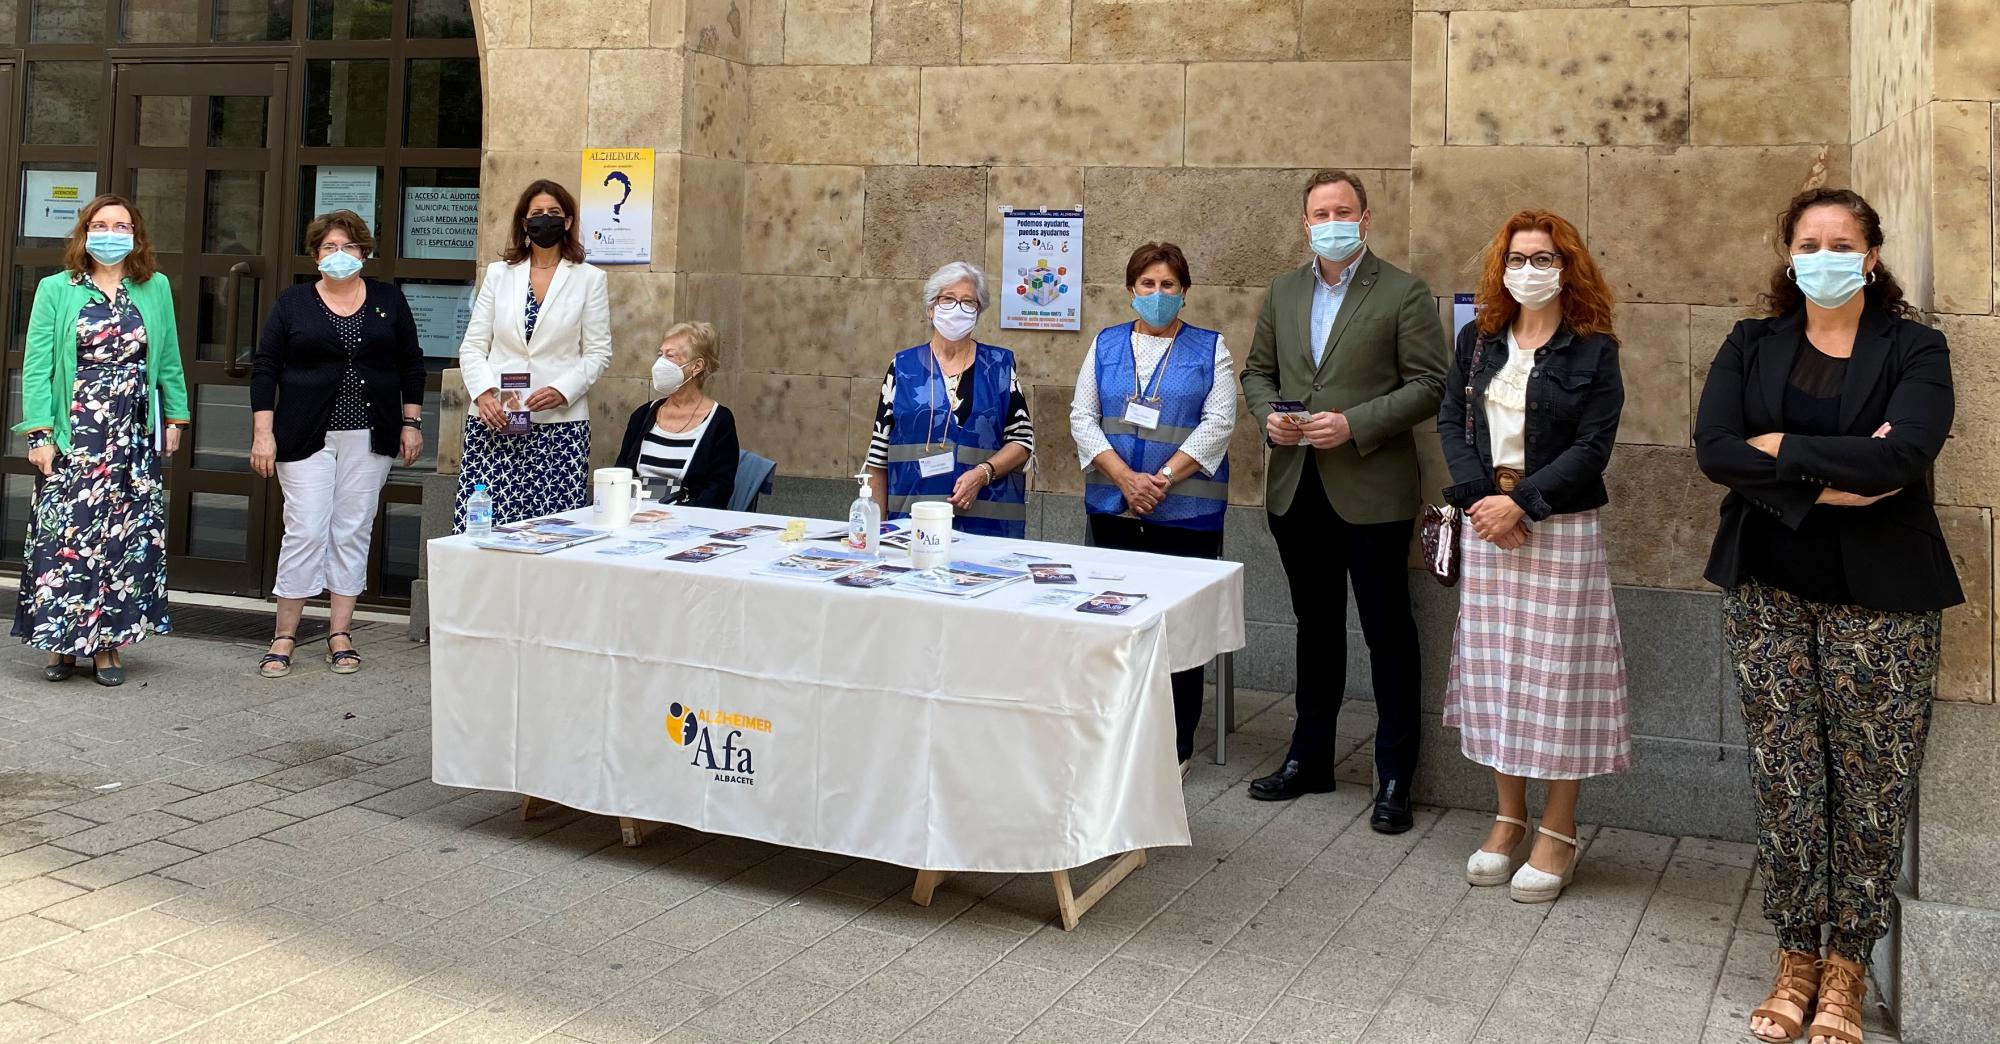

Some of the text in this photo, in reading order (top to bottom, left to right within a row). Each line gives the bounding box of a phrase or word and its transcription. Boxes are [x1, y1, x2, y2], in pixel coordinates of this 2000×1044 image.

[415, 204, 450, 212] MUNICIPAL
[459, 216, 479, 224] HORA
[1017, 219, 1043, 227] Podemos
[411, 227, 431, 235] ANTES
[1040, 229, 1070, 237] ayudarnos
[428, 238, 474, 247] ESPECTÁCULO
[922, 534, 940, 546] Afa
[698, 708, 772, 734] ALZHEIMER
[690, 726, 755, 775] Afa
[714, 774, 754, 786] ALBACETE
